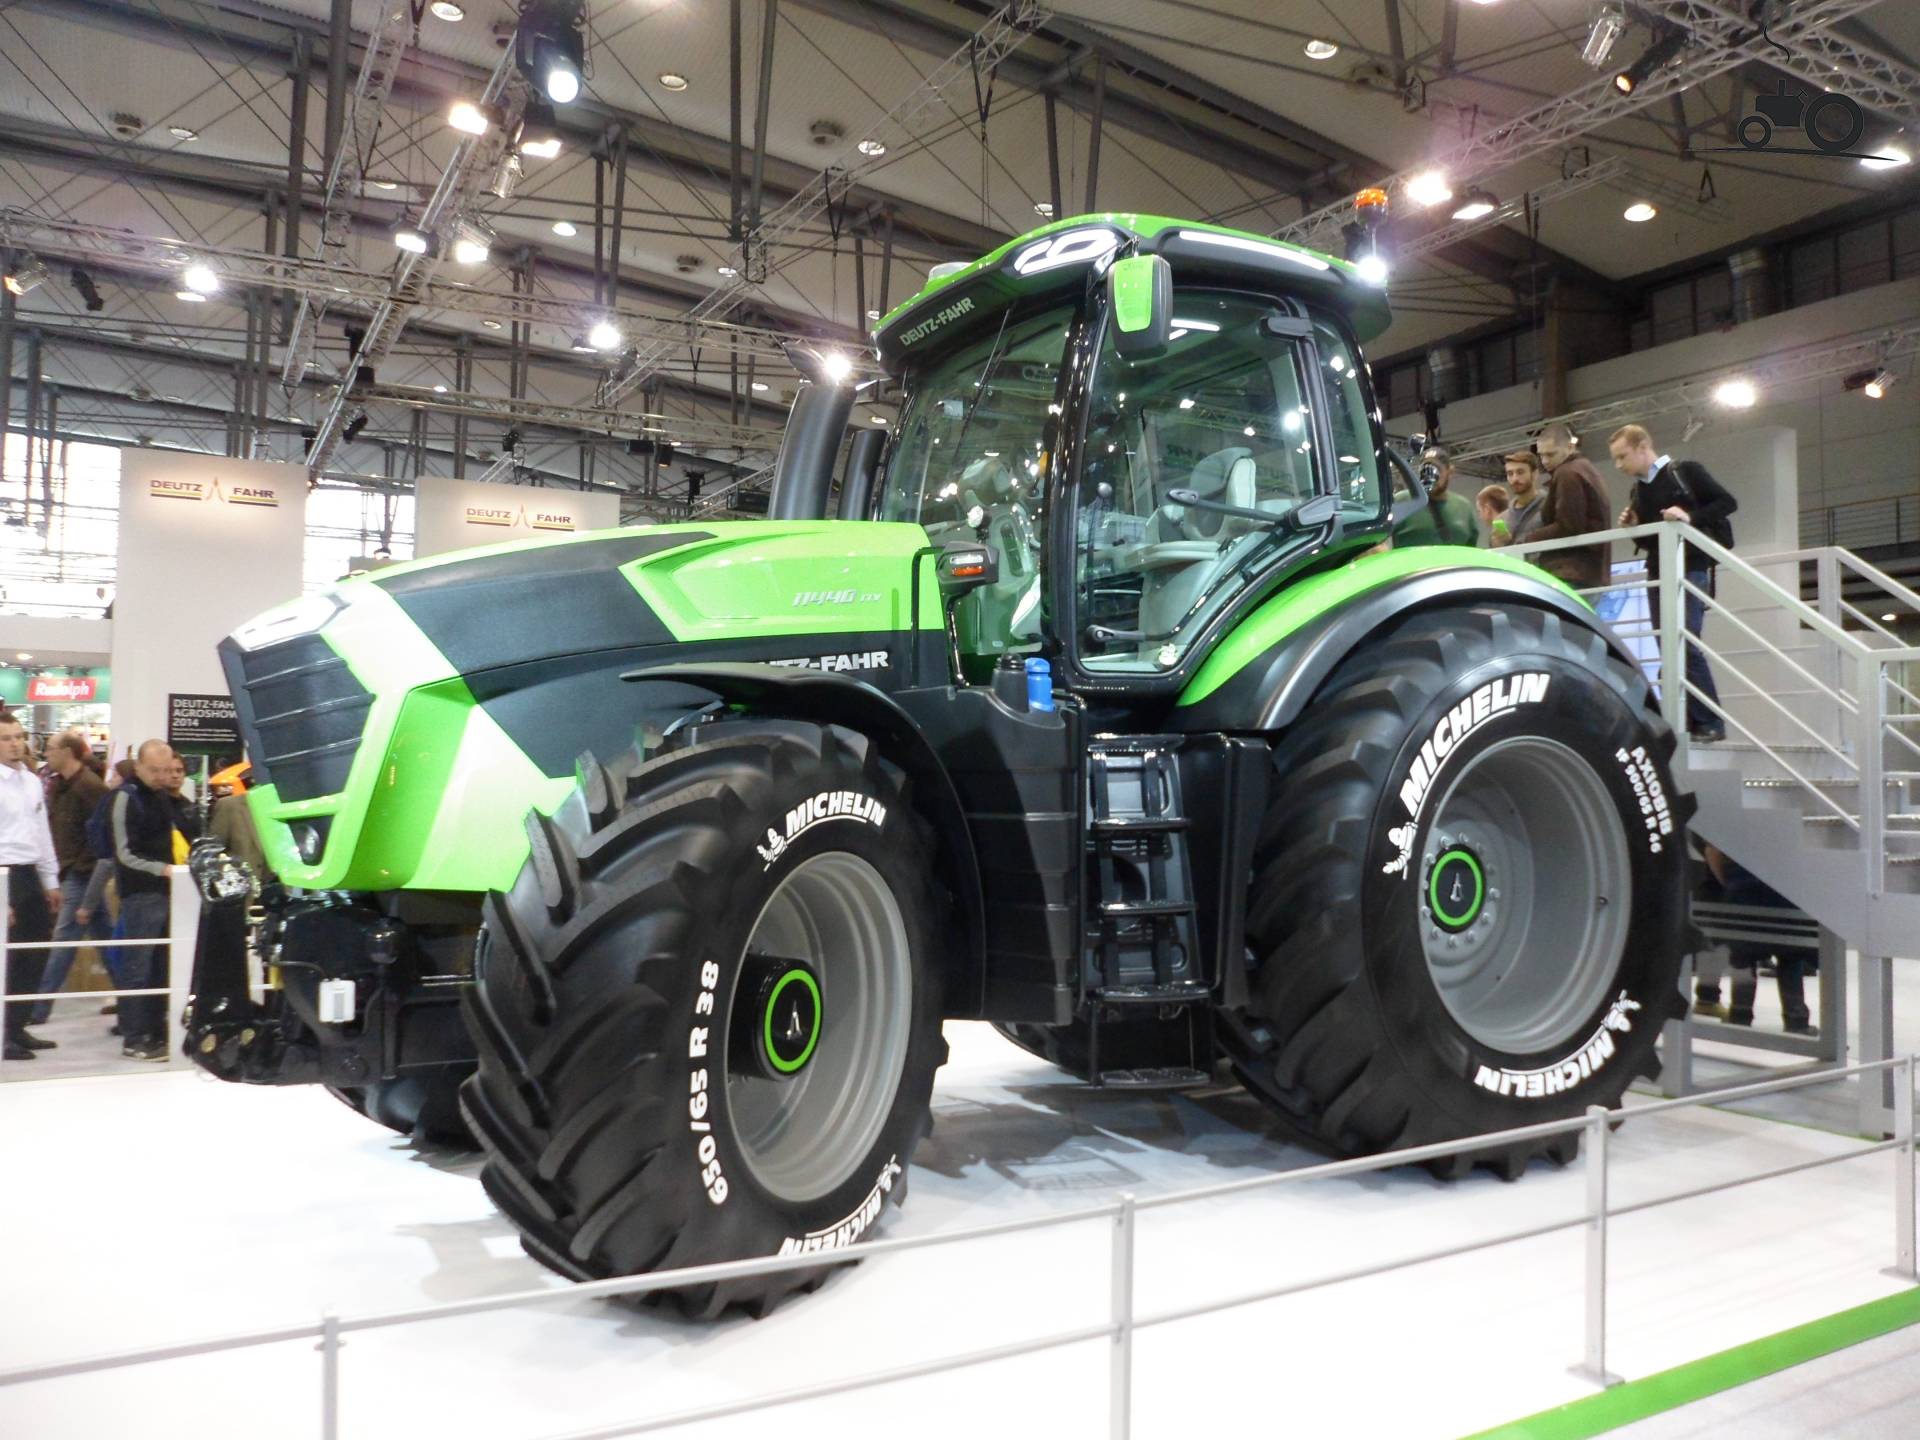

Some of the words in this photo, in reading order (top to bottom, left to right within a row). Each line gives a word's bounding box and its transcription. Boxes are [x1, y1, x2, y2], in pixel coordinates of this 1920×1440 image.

[899, 296, 976, 346] DEUTZ-FAHR
[150, 479, 203, 492] DEUTZ
[233, 487, 275, 499] FAHR
[466, 507, 512, 519] DEUTZ
[536, 513, 572, 524] FAHR
[172, 718, 200, 728] 2014
[173, 698, 235, 709] DEUTZ-FAH
[1399, 673, 1551, 817] MICHELIN
[785, 790, 887, 839] MICHELIN
[1630, 746, 1673, 836] AXIOBIB
[1645, 816, 1658, 830] R
[695, 960, 719, 1016] 38
[689, 1026, 709, 1058] R
[1474, 1030, 1616, 1098] MICHELIN
[689, 1068, 729, 1205] 650/65
[778, 1188, 882, 1257] MICHELIN
